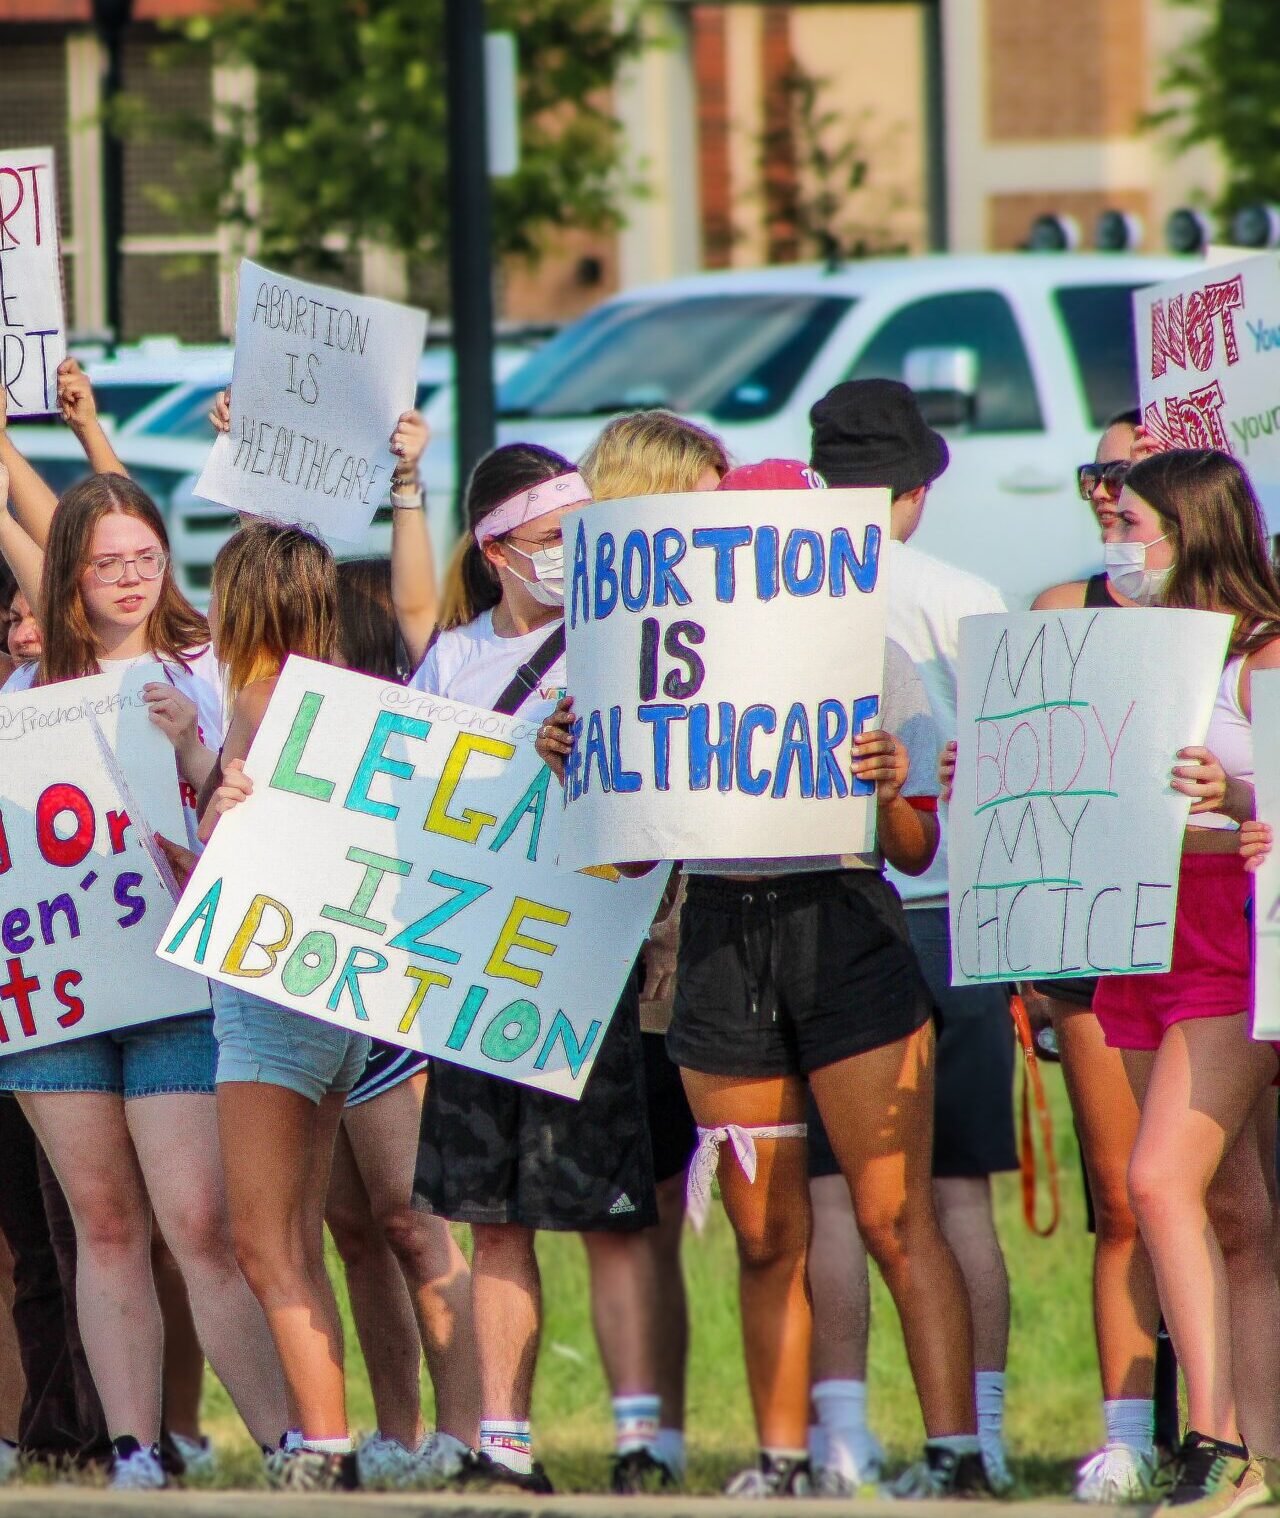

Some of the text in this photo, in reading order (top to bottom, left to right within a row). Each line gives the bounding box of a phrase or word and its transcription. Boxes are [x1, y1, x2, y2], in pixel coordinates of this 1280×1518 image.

[252, 282, 370, 356] ABORTION
[1151, 273, 1245, 380] NOT
[285, 352, 321, 405] IS
[1144, 379, 1231, 455] NOT
[233, 415, 386, 505] HEALTHCARE
[571, 518, 881, 629] ABORTION
[638, 617, 706, 701] IS
[981, 612, 1099, 717] MY
[268, 690, 621, 883] LEGA
[977, 701, 1136, 805] BODY
[977, 796, 1090, 886] MY
[320, 845, 571, 988] IZE
[166, 877, 602, 1080] ABORTION
